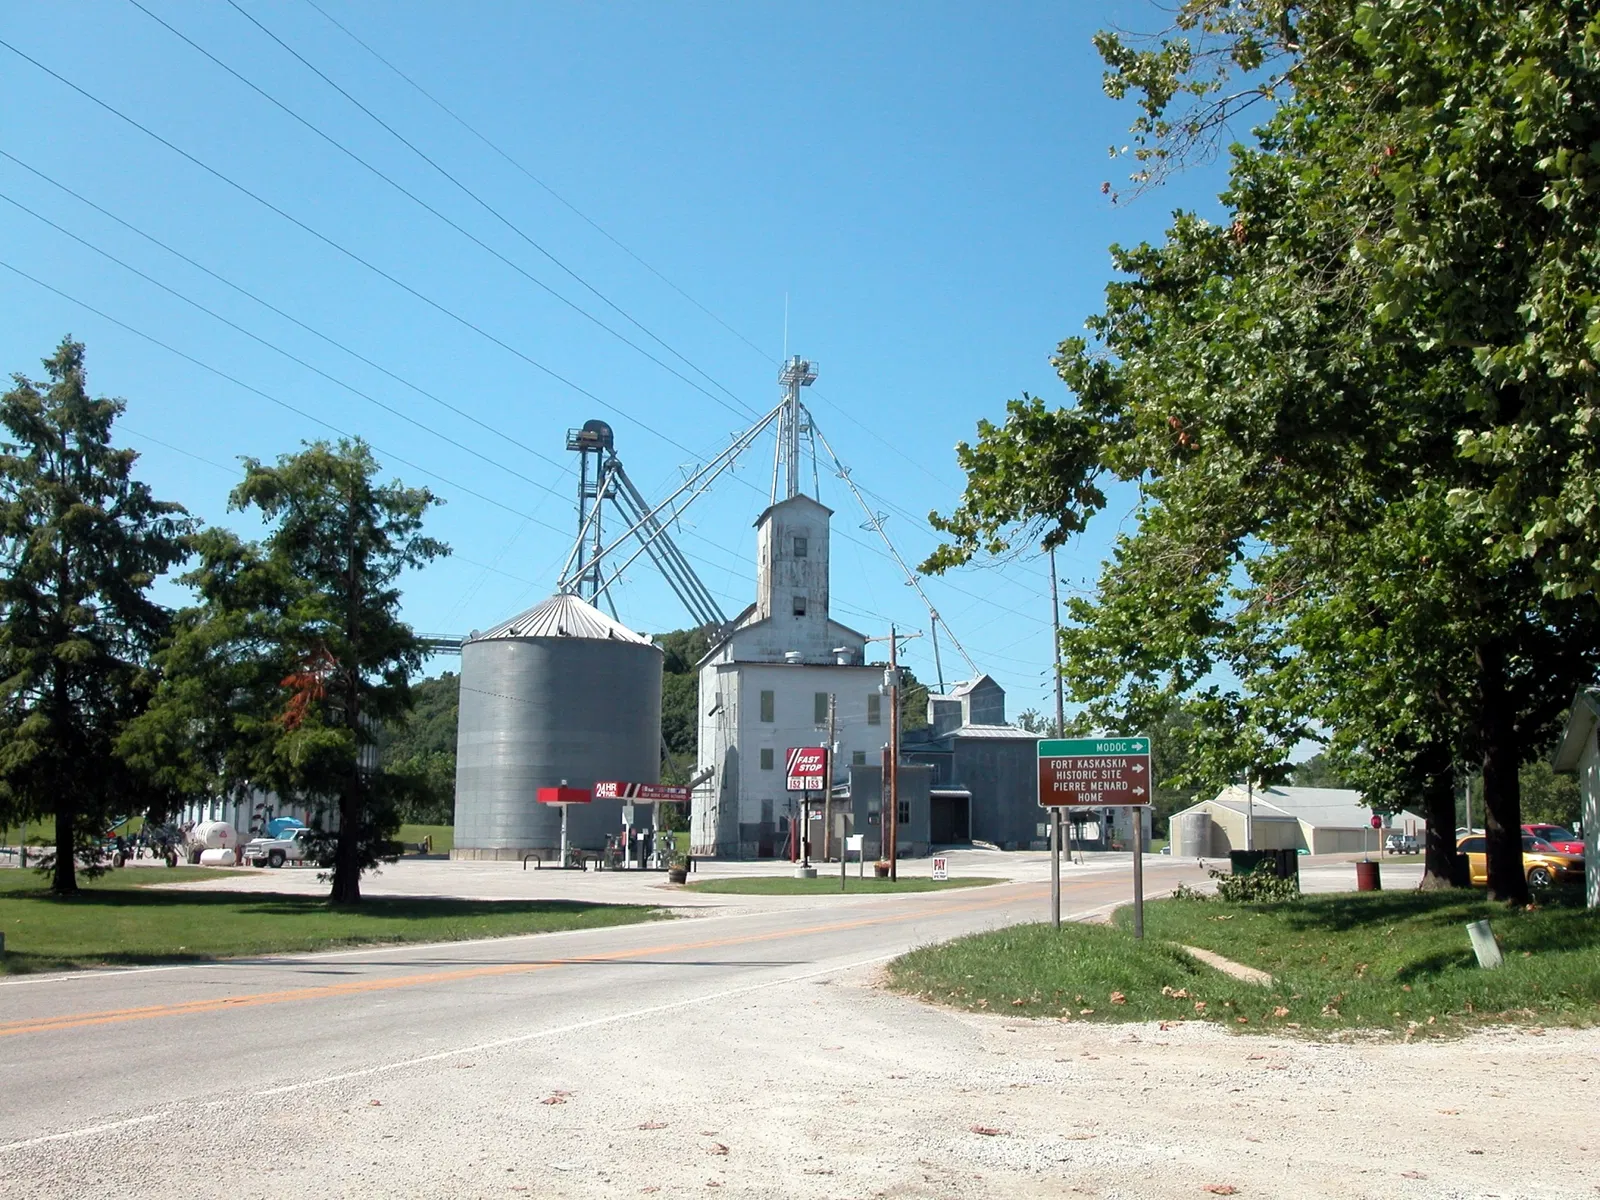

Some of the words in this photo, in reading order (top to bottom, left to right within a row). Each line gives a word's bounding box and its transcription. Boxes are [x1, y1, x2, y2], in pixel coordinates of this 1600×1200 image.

[1096, 742, 1127, 752] MODOC
[799, 764, 822, 772] STOP
[1050, 760, 1073, 769] FORT
[1077, 759, 1127, 768] KASKASKIA
[1056, 770, 1098, 780] HISTORIC
[1101, 770, 1122, 779] SITE
[596, 783, 605, 797] 24
[606, 783, 616, 791] HR
[1053, 782, 1086, 791] PIERRE
[1090, 781, 1128, 791] MENARD
[1078, 793, 1103, 802] HOME
[934, 859, 945, 870] PAY
